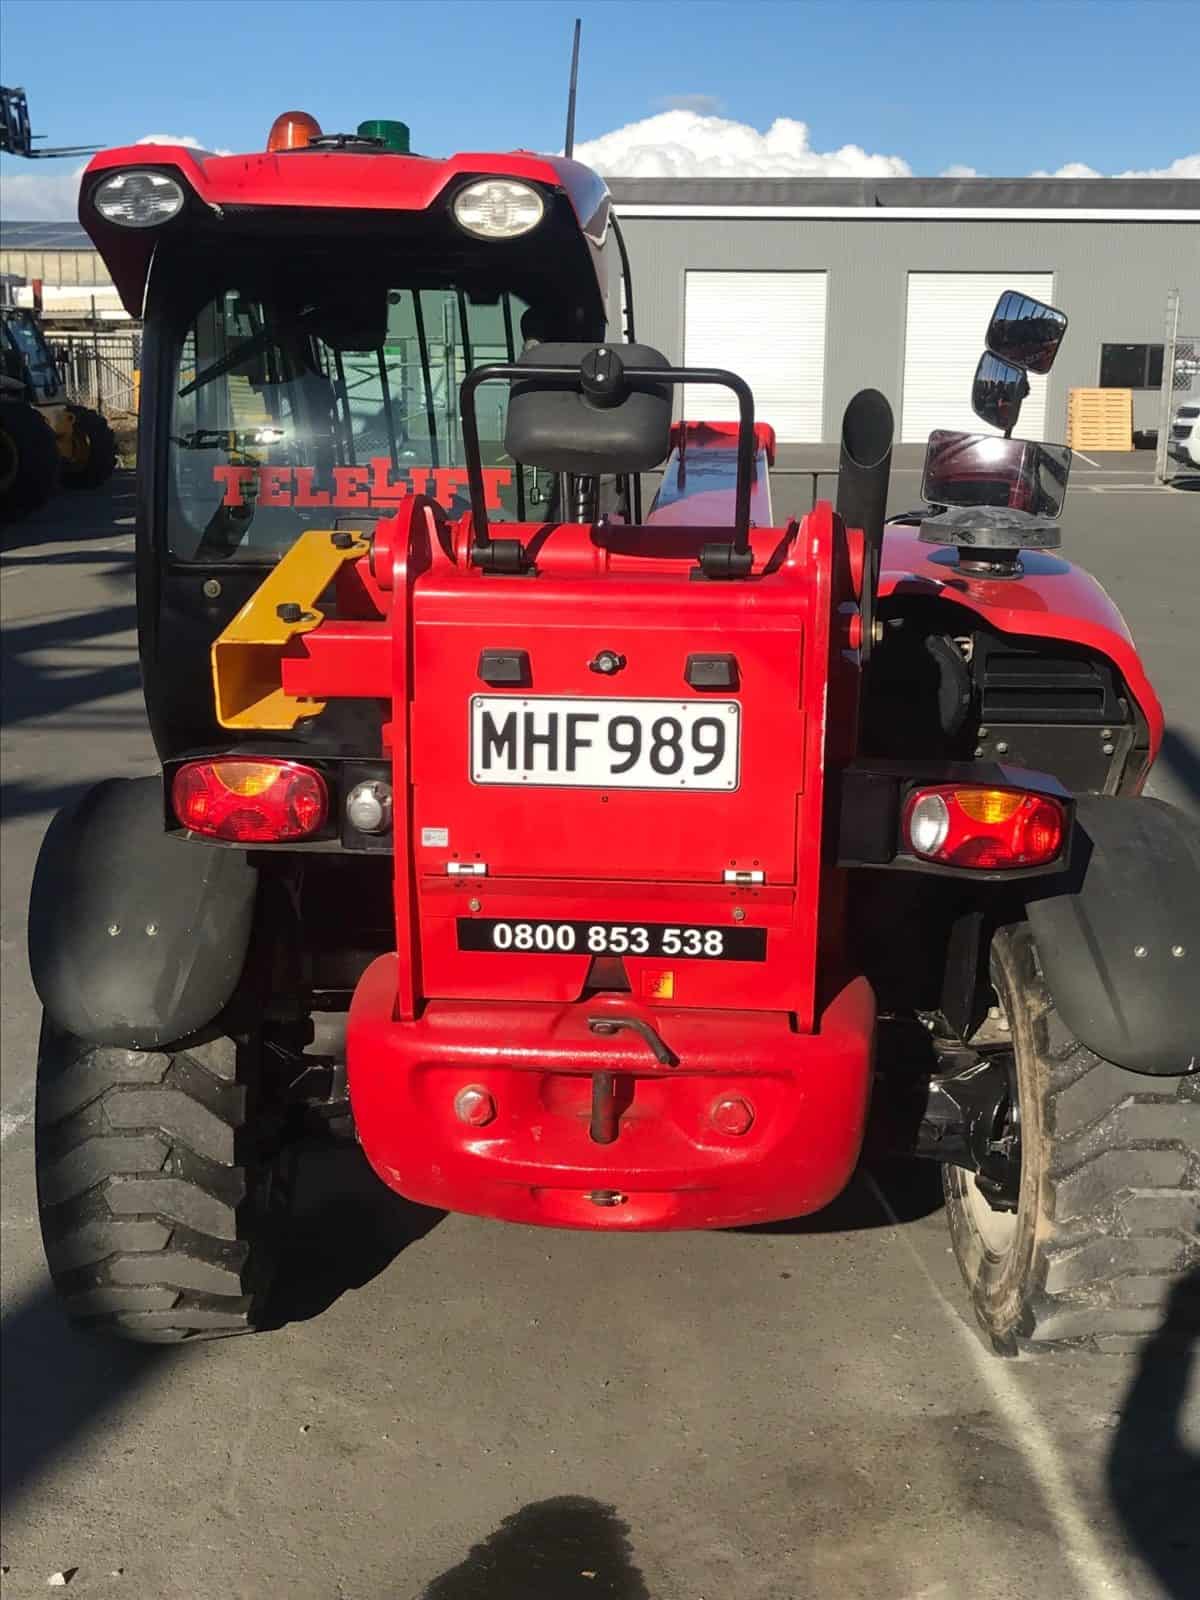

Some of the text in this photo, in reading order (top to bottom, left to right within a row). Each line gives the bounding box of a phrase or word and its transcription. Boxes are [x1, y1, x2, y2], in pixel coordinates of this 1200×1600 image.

[481, 711, 726, 775] MHF989
[493, 923, 724, 956] 0800 853 538
